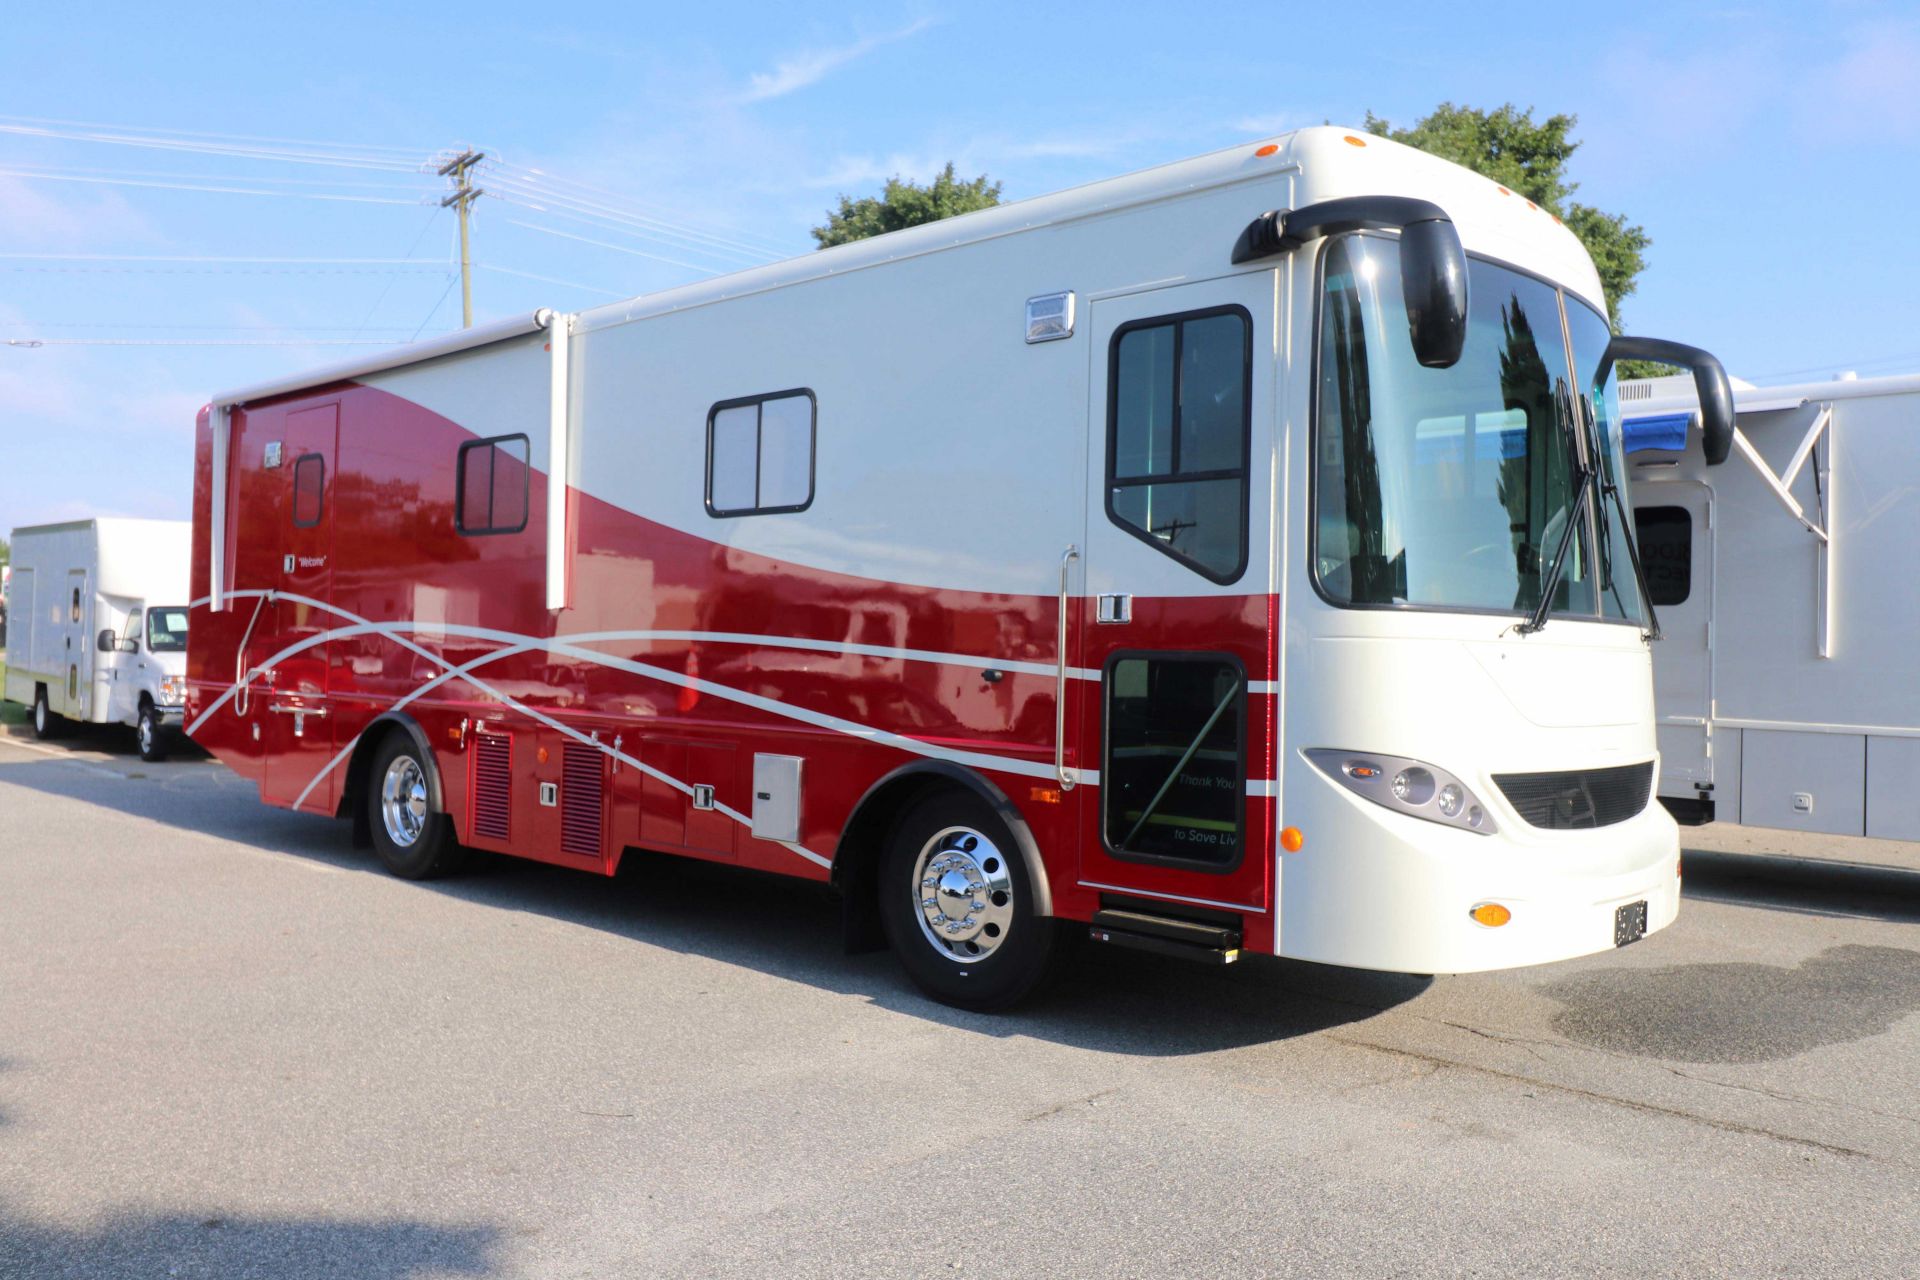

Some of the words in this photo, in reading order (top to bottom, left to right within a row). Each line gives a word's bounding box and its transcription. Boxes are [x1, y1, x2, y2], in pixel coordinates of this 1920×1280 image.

[1180, 774, 1212, 786] Thank
[1216, 777, 1235, 789] You
[1175, 830, 1186, 840] to
[1189, 830, 1216, 843] Save
